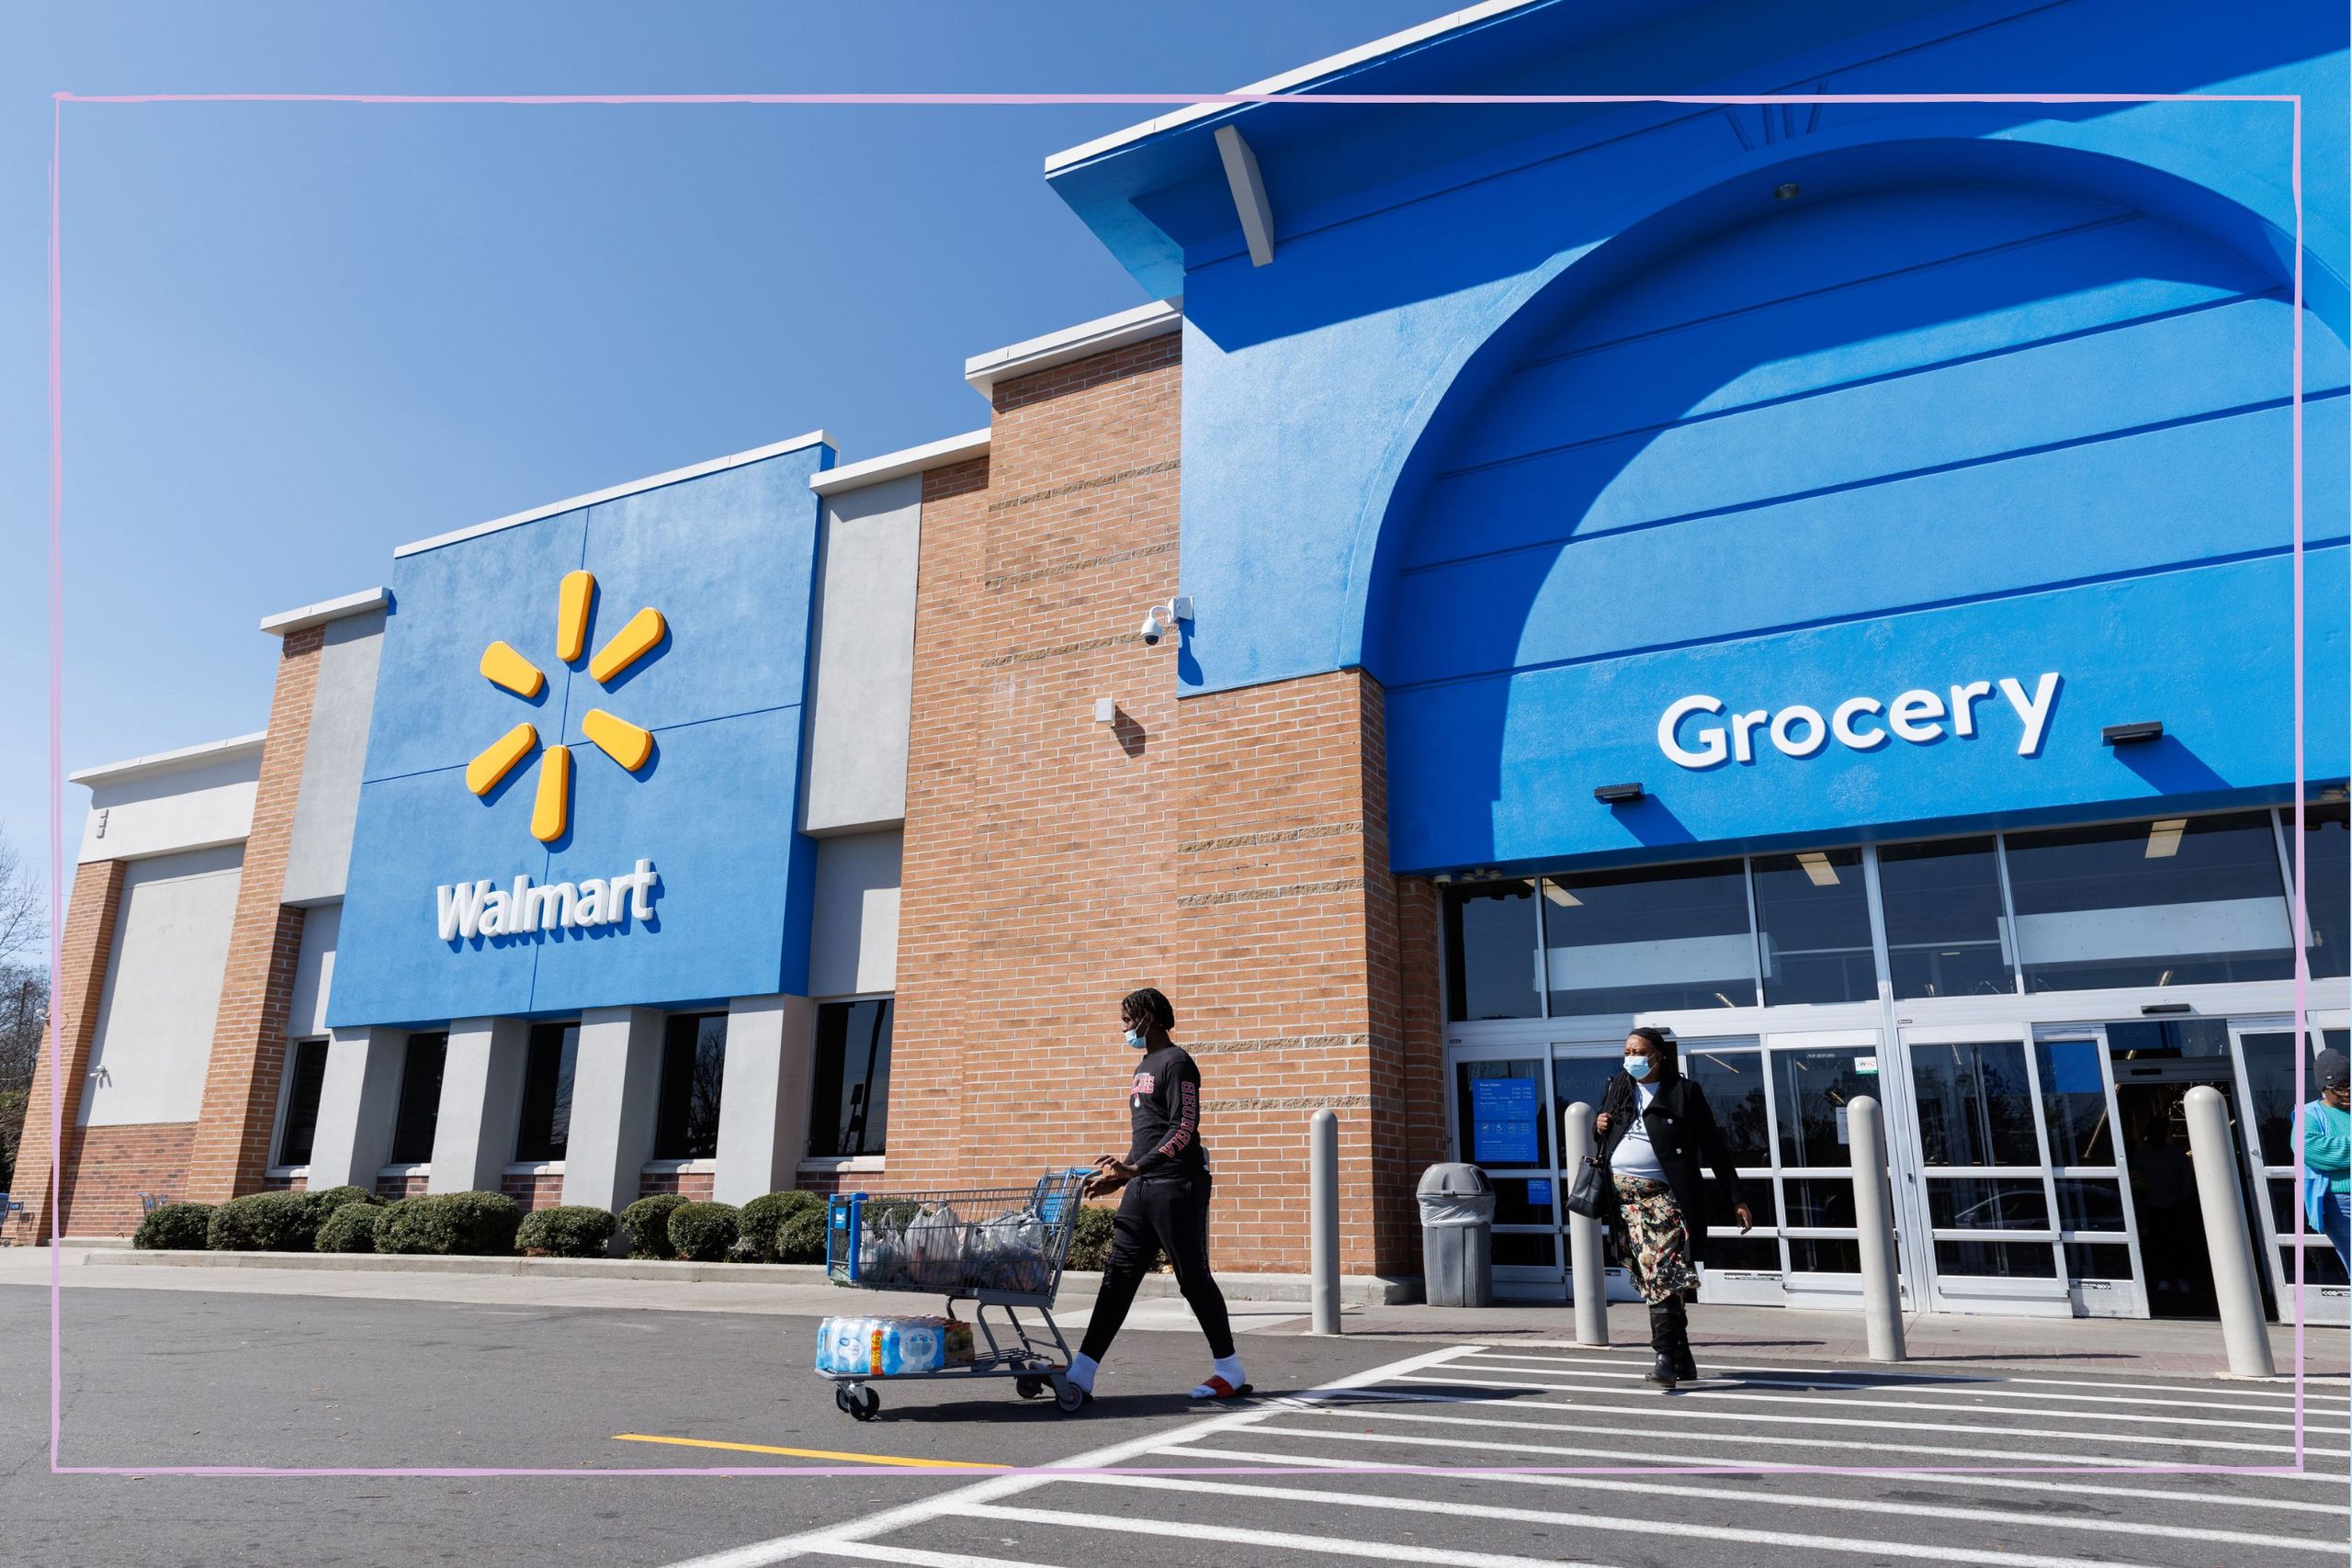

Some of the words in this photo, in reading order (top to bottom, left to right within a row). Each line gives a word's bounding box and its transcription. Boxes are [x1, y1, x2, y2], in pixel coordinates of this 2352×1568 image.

[1657, 671, 2059, 768] Grocery
[437, 858, 657, 942] Walmart
[1159, 1080, 1196, 1158] GEORGIA
